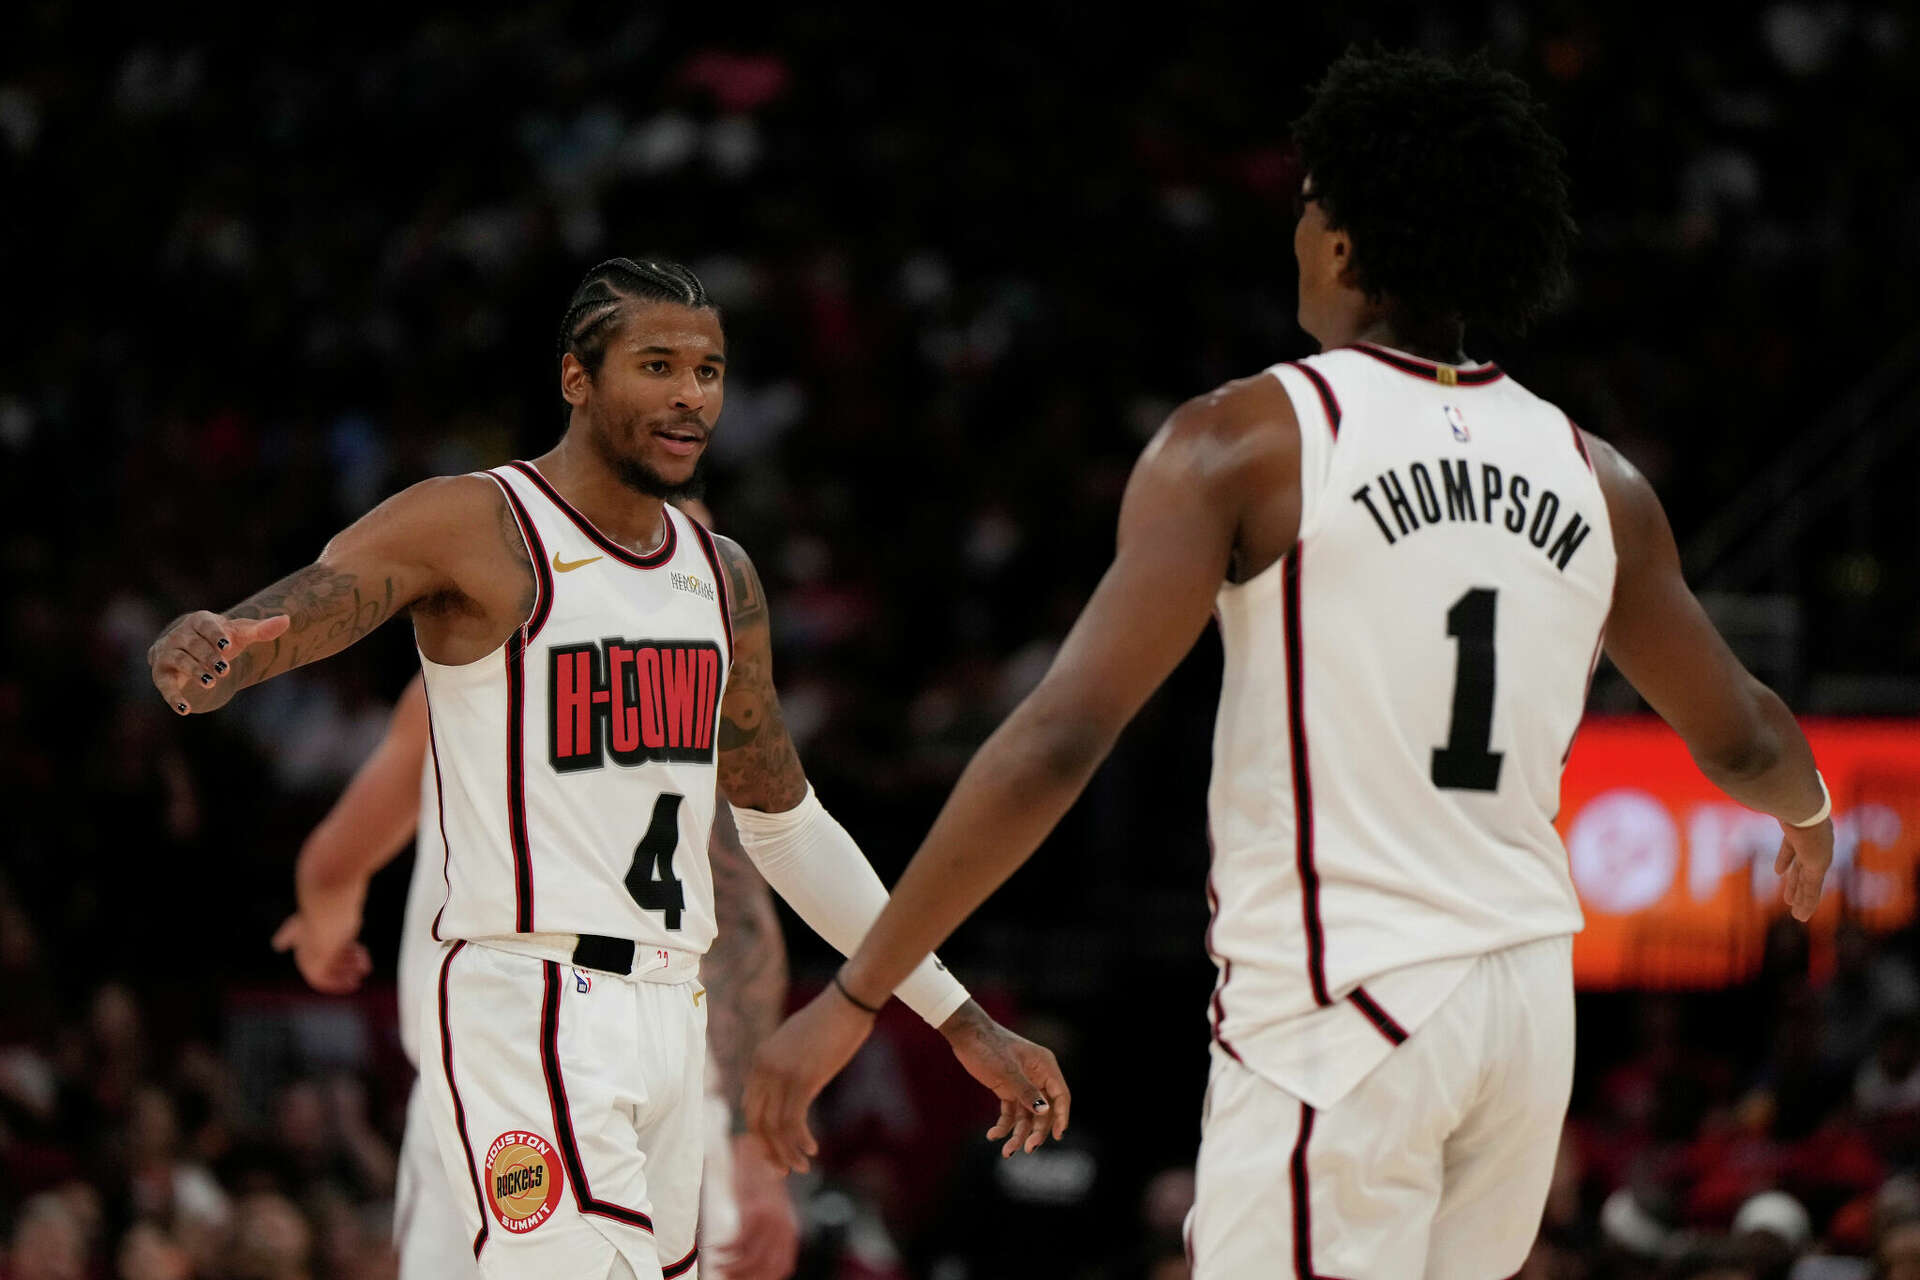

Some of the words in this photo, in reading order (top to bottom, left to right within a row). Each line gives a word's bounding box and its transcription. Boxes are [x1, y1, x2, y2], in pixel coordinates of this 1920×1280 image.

[1351, 458, 1592, 574] THOMPSON
[1430, 587, 1505, 792] 1
[622, 791, 686, 932] 4
[486, 1133, 551, 1170] HOUSTON
[500, 1201, 551, 1231] SUMMIT
